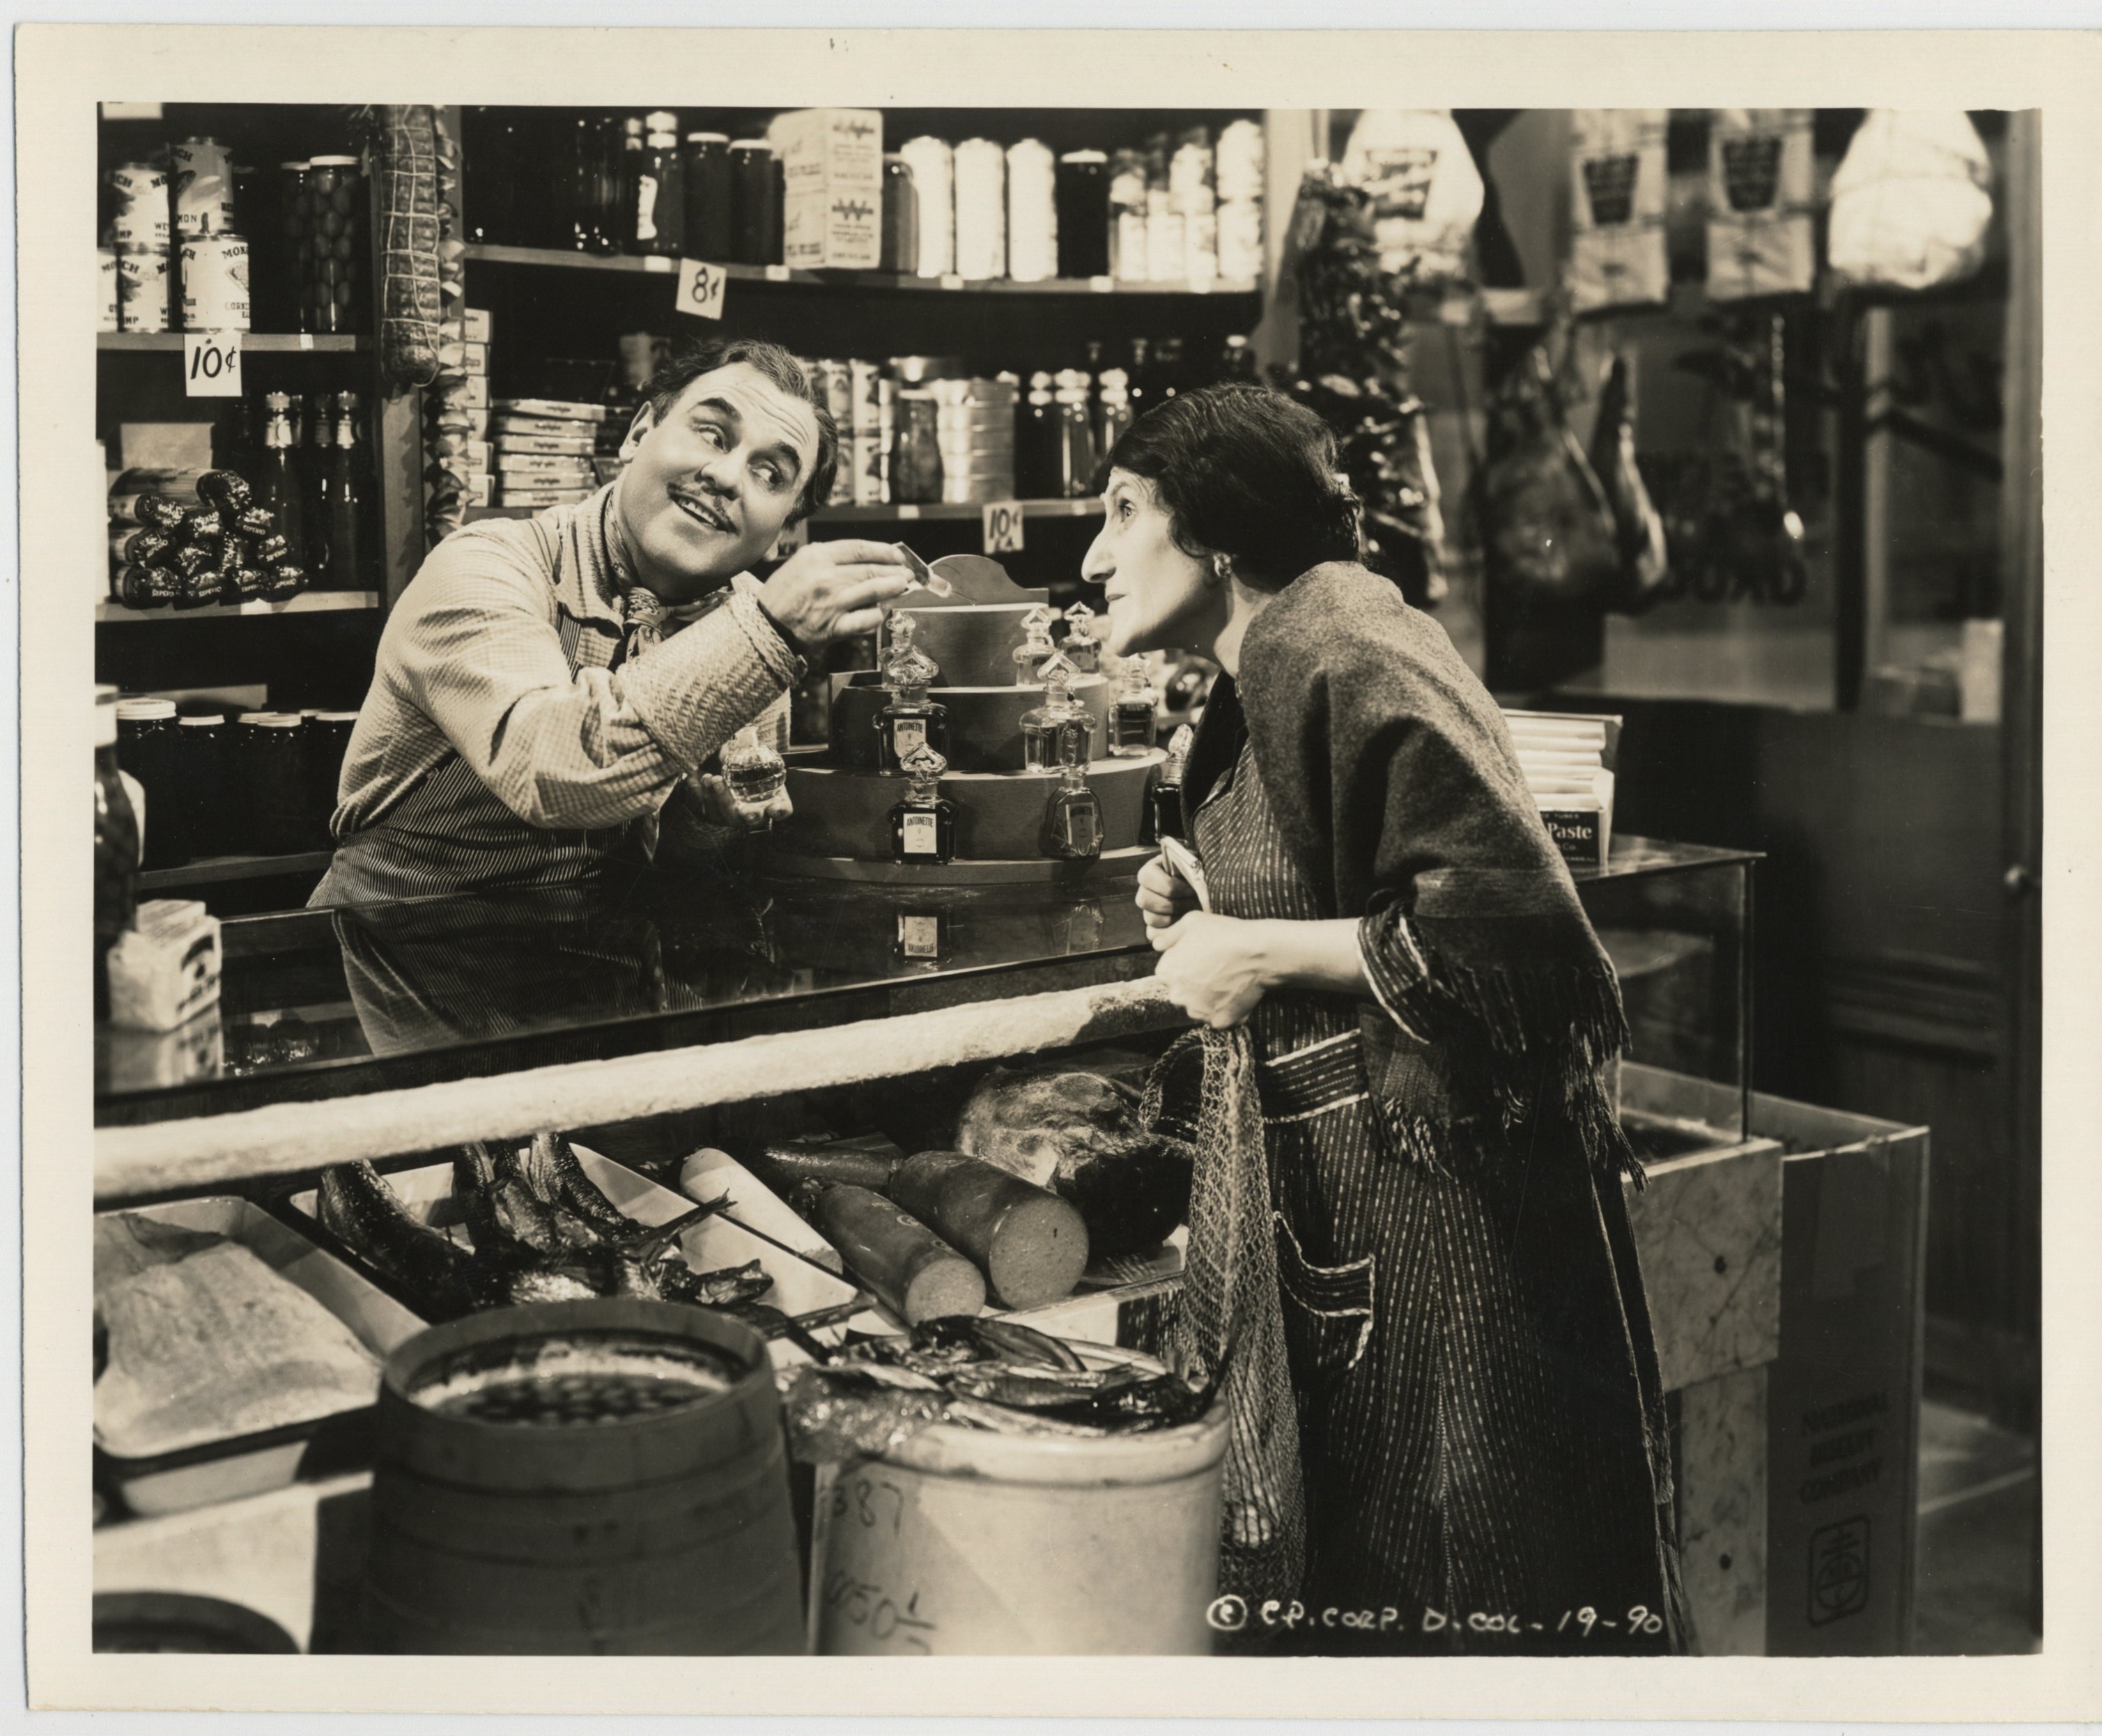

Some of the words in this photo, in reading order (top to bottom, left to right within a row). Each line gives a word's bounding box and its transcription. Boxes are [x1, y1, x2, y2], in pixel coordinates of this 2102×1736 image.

[692, 266, 720, 304] 8¢
[190, 346, 237, 380] 10¢
[897, 722, 923, 733] ANTOINETTE
[906, 816, 934, 828] ANTOINETTE
[1547, 822, 1593, 840] Paste
